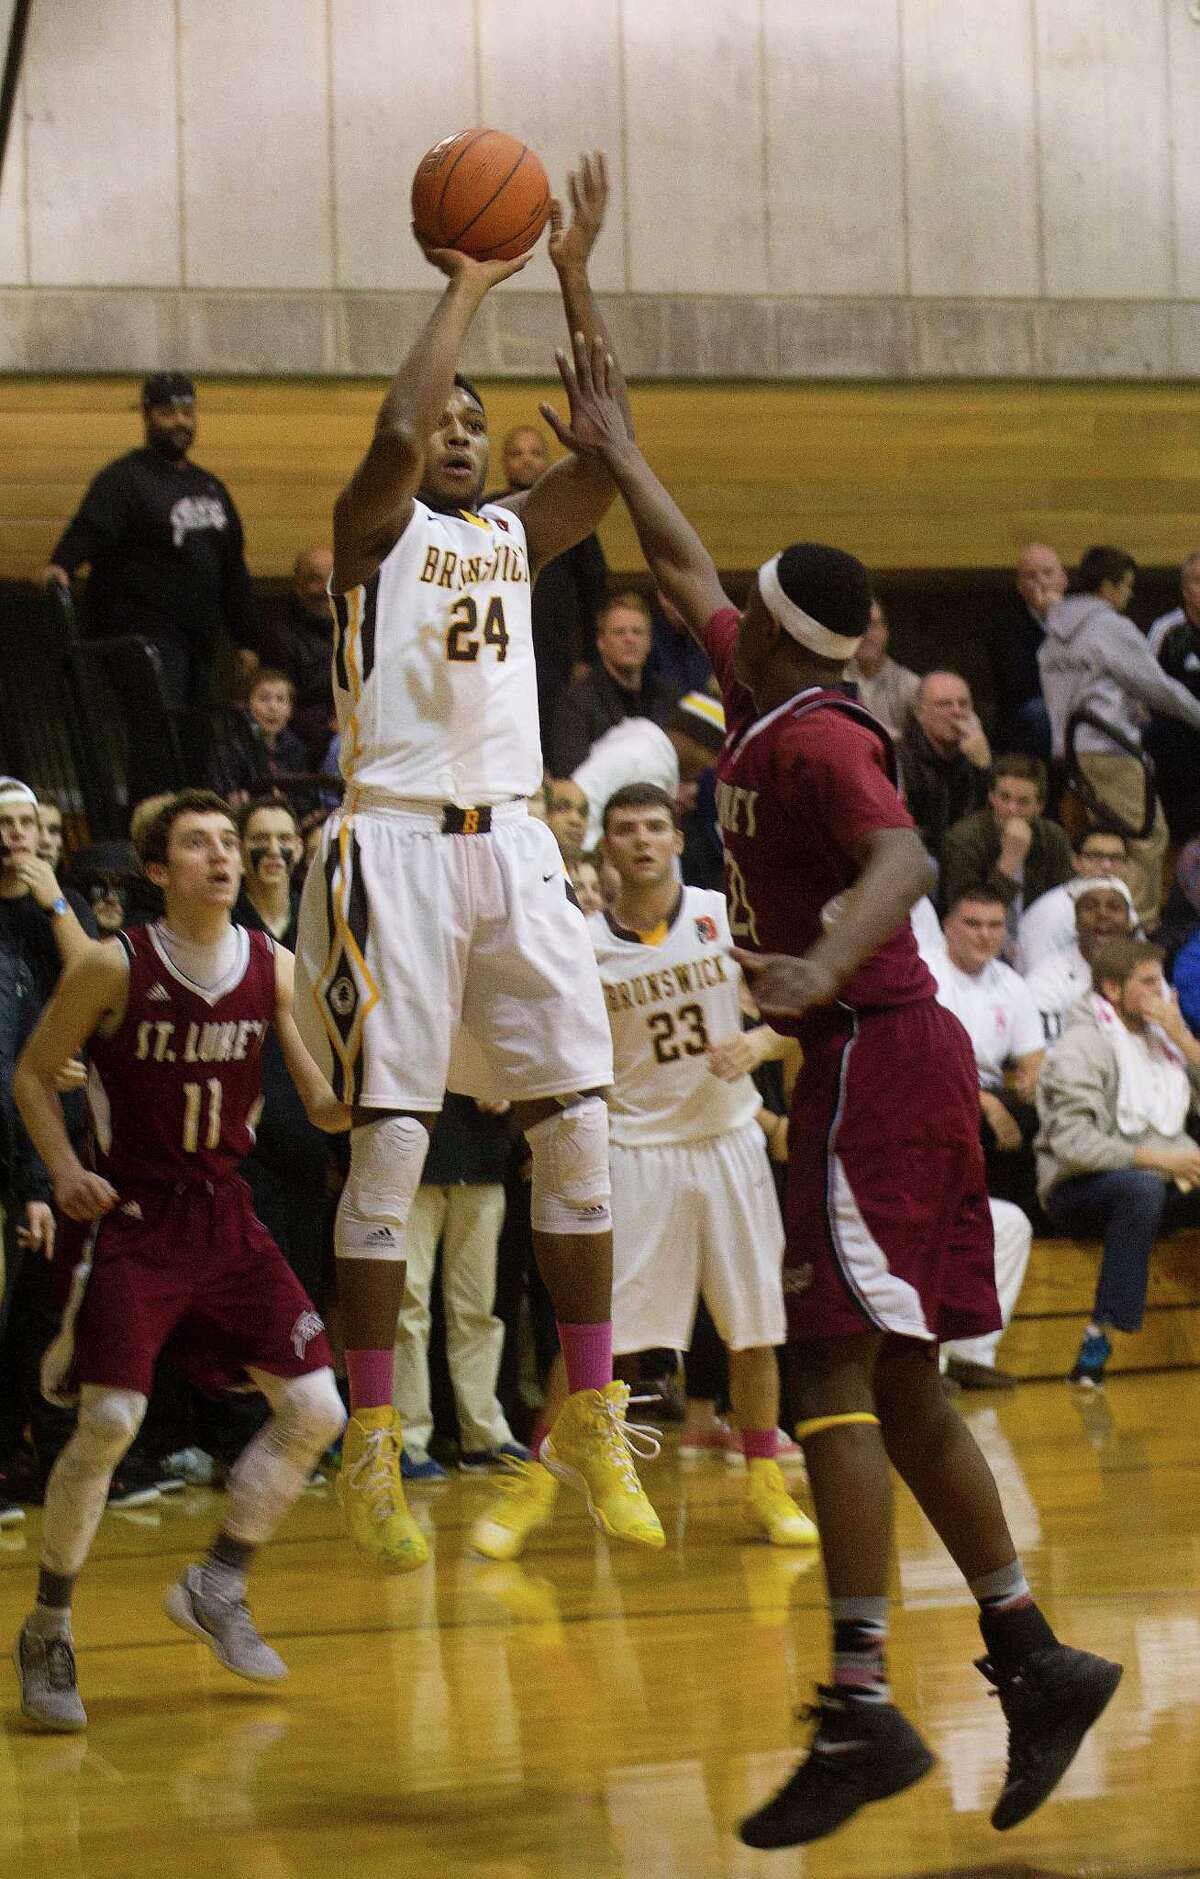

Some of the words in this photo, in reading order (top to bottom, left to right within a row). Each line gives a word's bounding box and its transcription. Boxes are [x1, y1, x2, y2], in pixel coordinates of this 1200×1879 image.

[446, 595, 509, 662] 24
[134, 1020, 177, 1063] ST.
[182, 1018, 268, 1063] LUKE'
[647, 1003, 708, 1064] 23
[182, 1077, 223, 1153] 11
